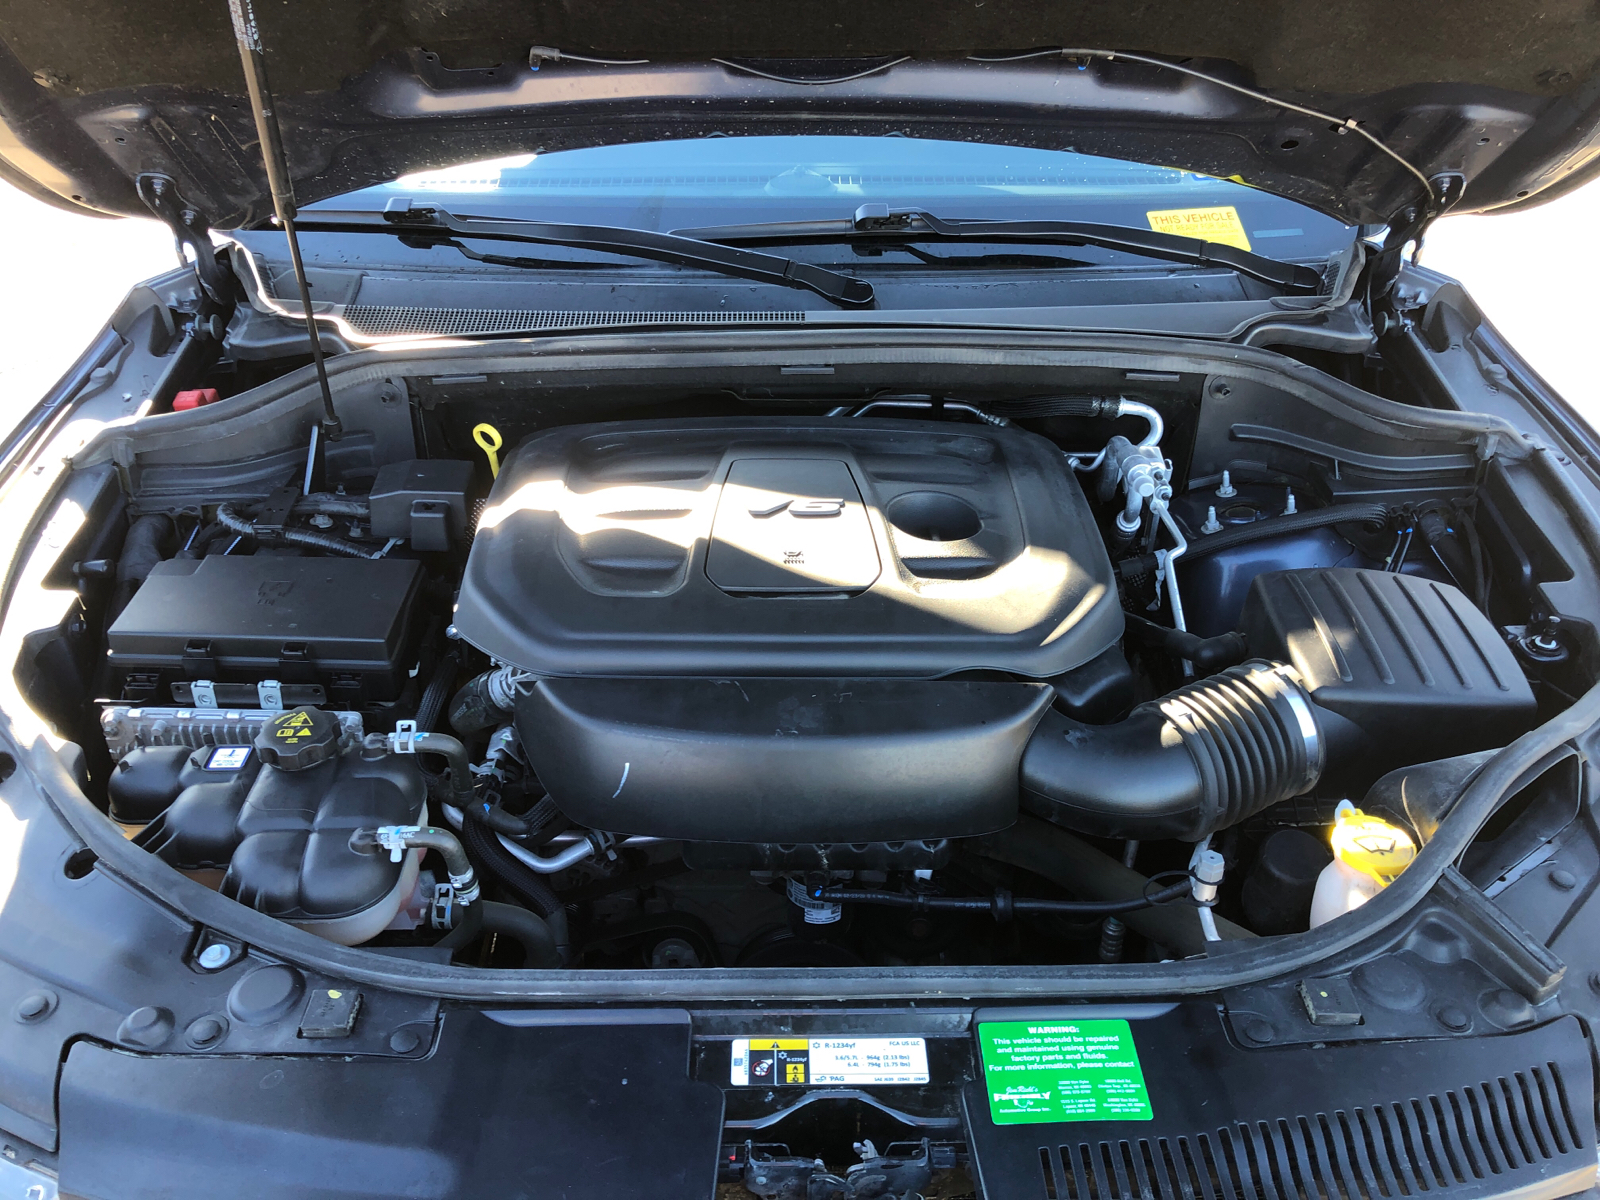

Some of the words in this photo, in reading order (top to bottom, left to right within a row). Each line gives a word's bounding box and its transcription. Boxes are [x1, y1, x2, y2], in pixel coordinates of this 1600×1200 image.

[1152, 215, 1181, 225] THIS
[1183, 212, 1235, 223] VEHICLE
[1027, 1026, 1080, 1034] WARNING:
[1012, 1037, 1042, 1045] vehicle
[1043, 1036, 1072, 1044] should
[1085, 1035, 1120, 1044] repaired
[824, 1042, 856, 1050] R-1234yf
[996, 1046, 1013, 1054] and
[1014, 1045, 1060, 1053] maintained
[1060, 1045, 1085, 1053] using
[1086, 1044, 1120, 1052] genuine
[883, 1054, 898, 1062] (2.13
[1011, 1054, 1040, 1063] factory
[1042, 1054, 1064, 1062] parts
[1065, 1053, 1081, 1061] and
[867, 1061, 881, 1069] 794g
[988, 1064, 1003, 1072] For
[1004, 1063, 1026, 1071] more
[1077, 1061, 1103, 1070] please
[1104, 1060, 1135, 1068] contact
